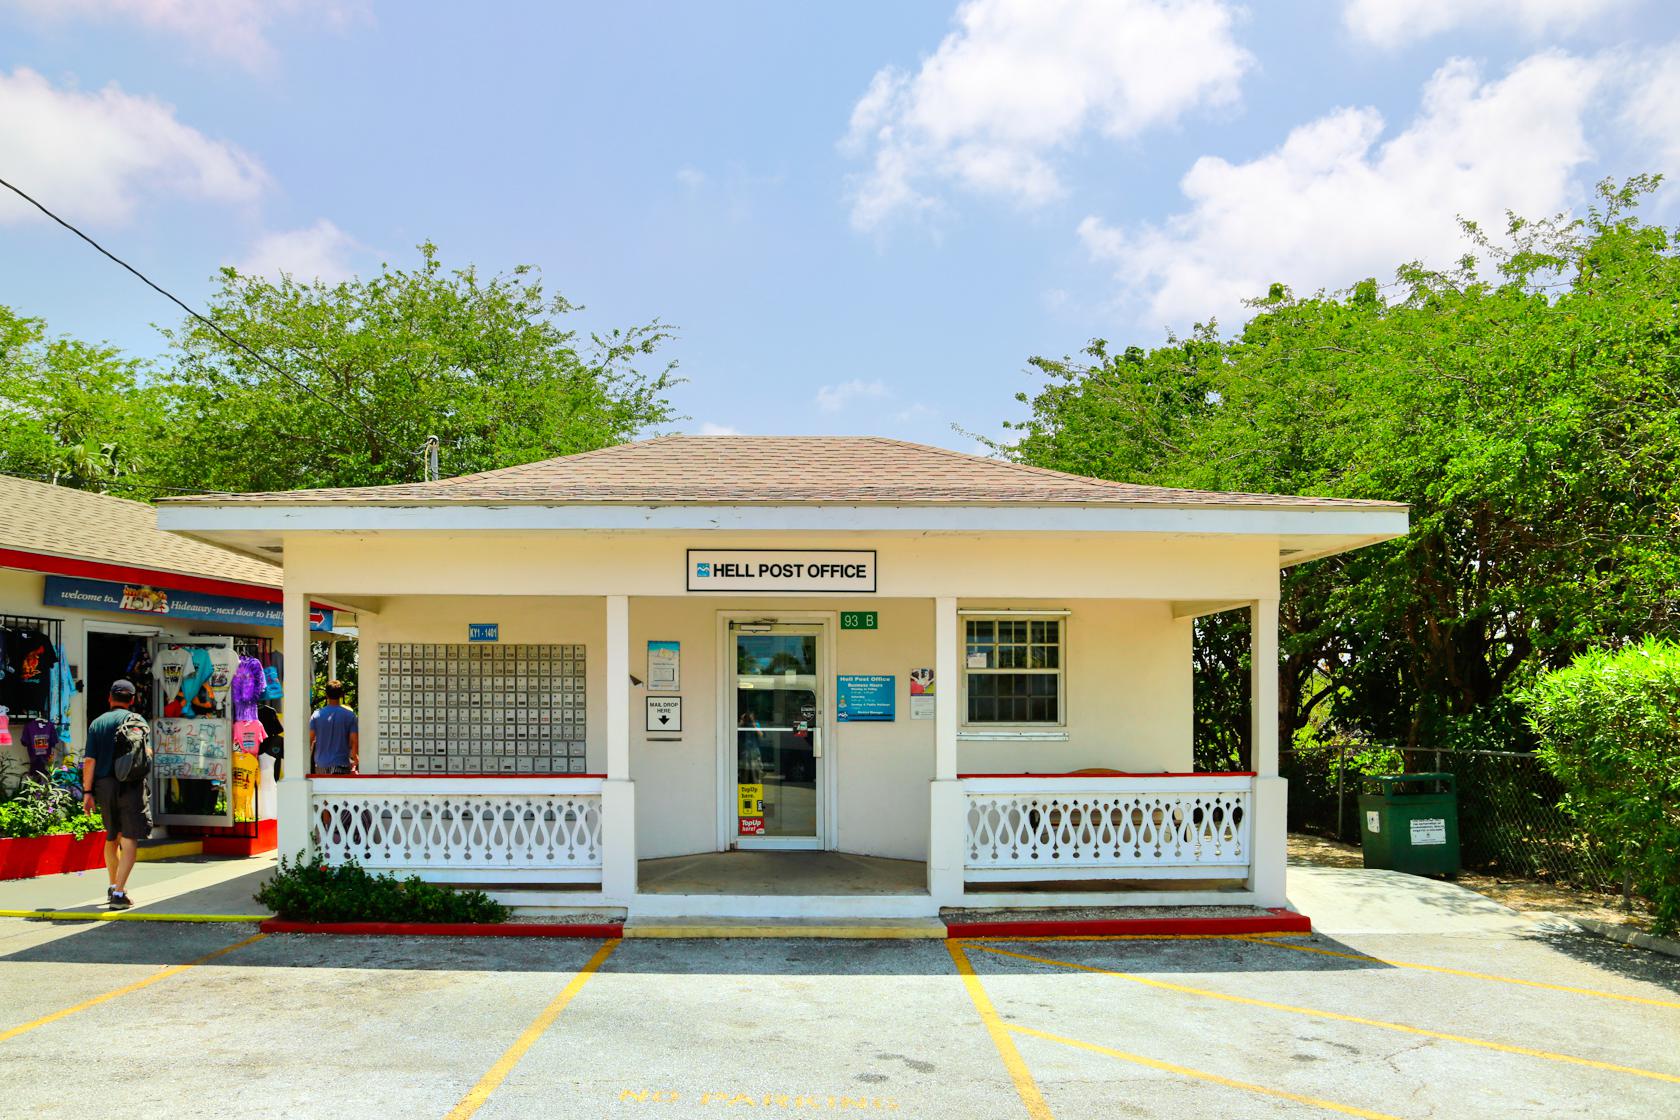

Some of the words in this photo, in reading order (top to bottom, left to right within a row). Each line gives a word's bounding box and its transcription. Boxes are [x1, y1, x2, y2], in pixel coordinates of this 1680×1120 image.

[713, 563, 755, 578] HELL
[759, 563, 804, 578] POST
[808, 564, 867, 578] OFFICE
[60, 589, 103, 602] welcome
[236, 607, 255, 617] door
[256, 610, 265, 618] to
[844, 615, 859, 627] 93
[866, 615, 874, 627] B
[741, 819, 762, 827] TopUp
[619, 1089, 680, 1103] NO
[700, 1091, 900, 1110] PARKING
